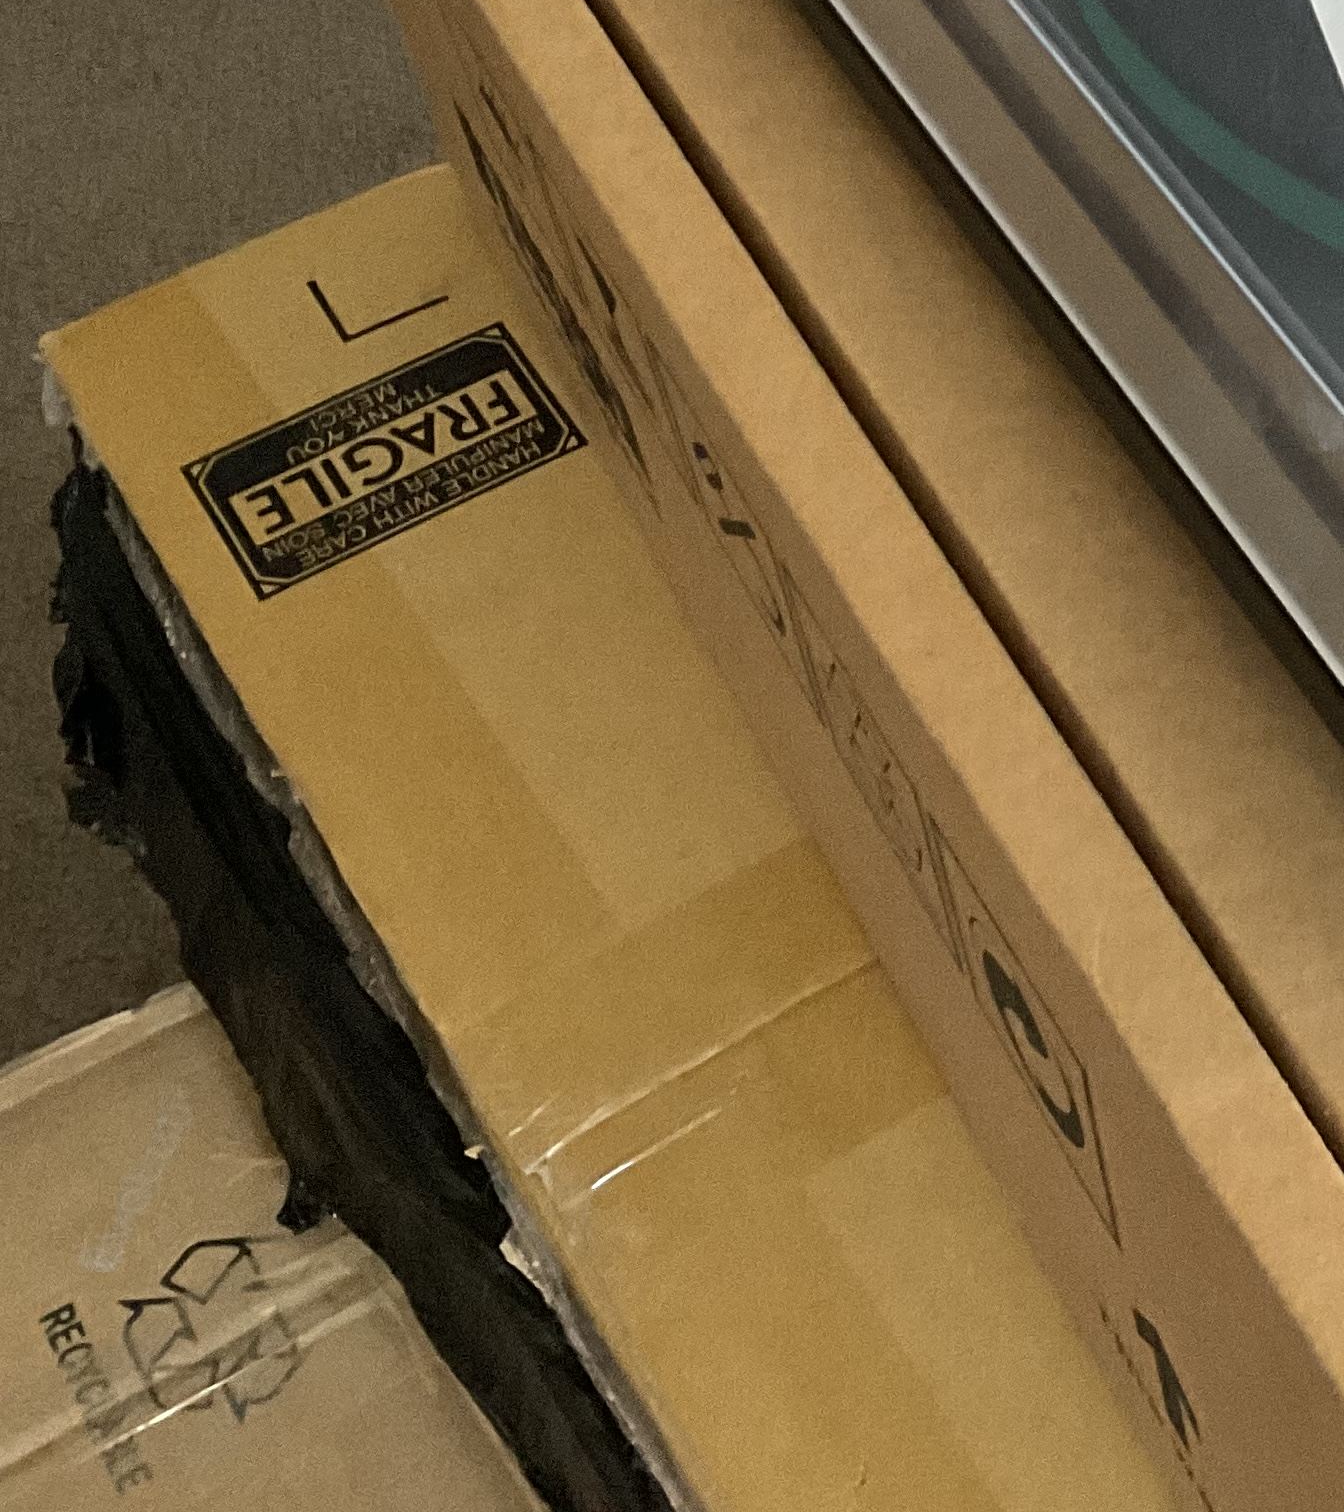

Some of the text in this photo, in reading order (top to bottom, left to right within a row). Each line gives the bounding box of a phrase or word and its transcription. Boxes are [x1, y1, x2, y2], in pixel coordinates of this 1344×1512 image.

[282, 382, 441, 464] THANK YOU
[307, 382, 396, 431] MERCI
[242, 378, 522, 535] FRAGILE
[293, 439, 541, 567] HANDLE WITH CARE
[330, 486, 400, 528] AVEC
[260, 521, 327, 562] SOIN
